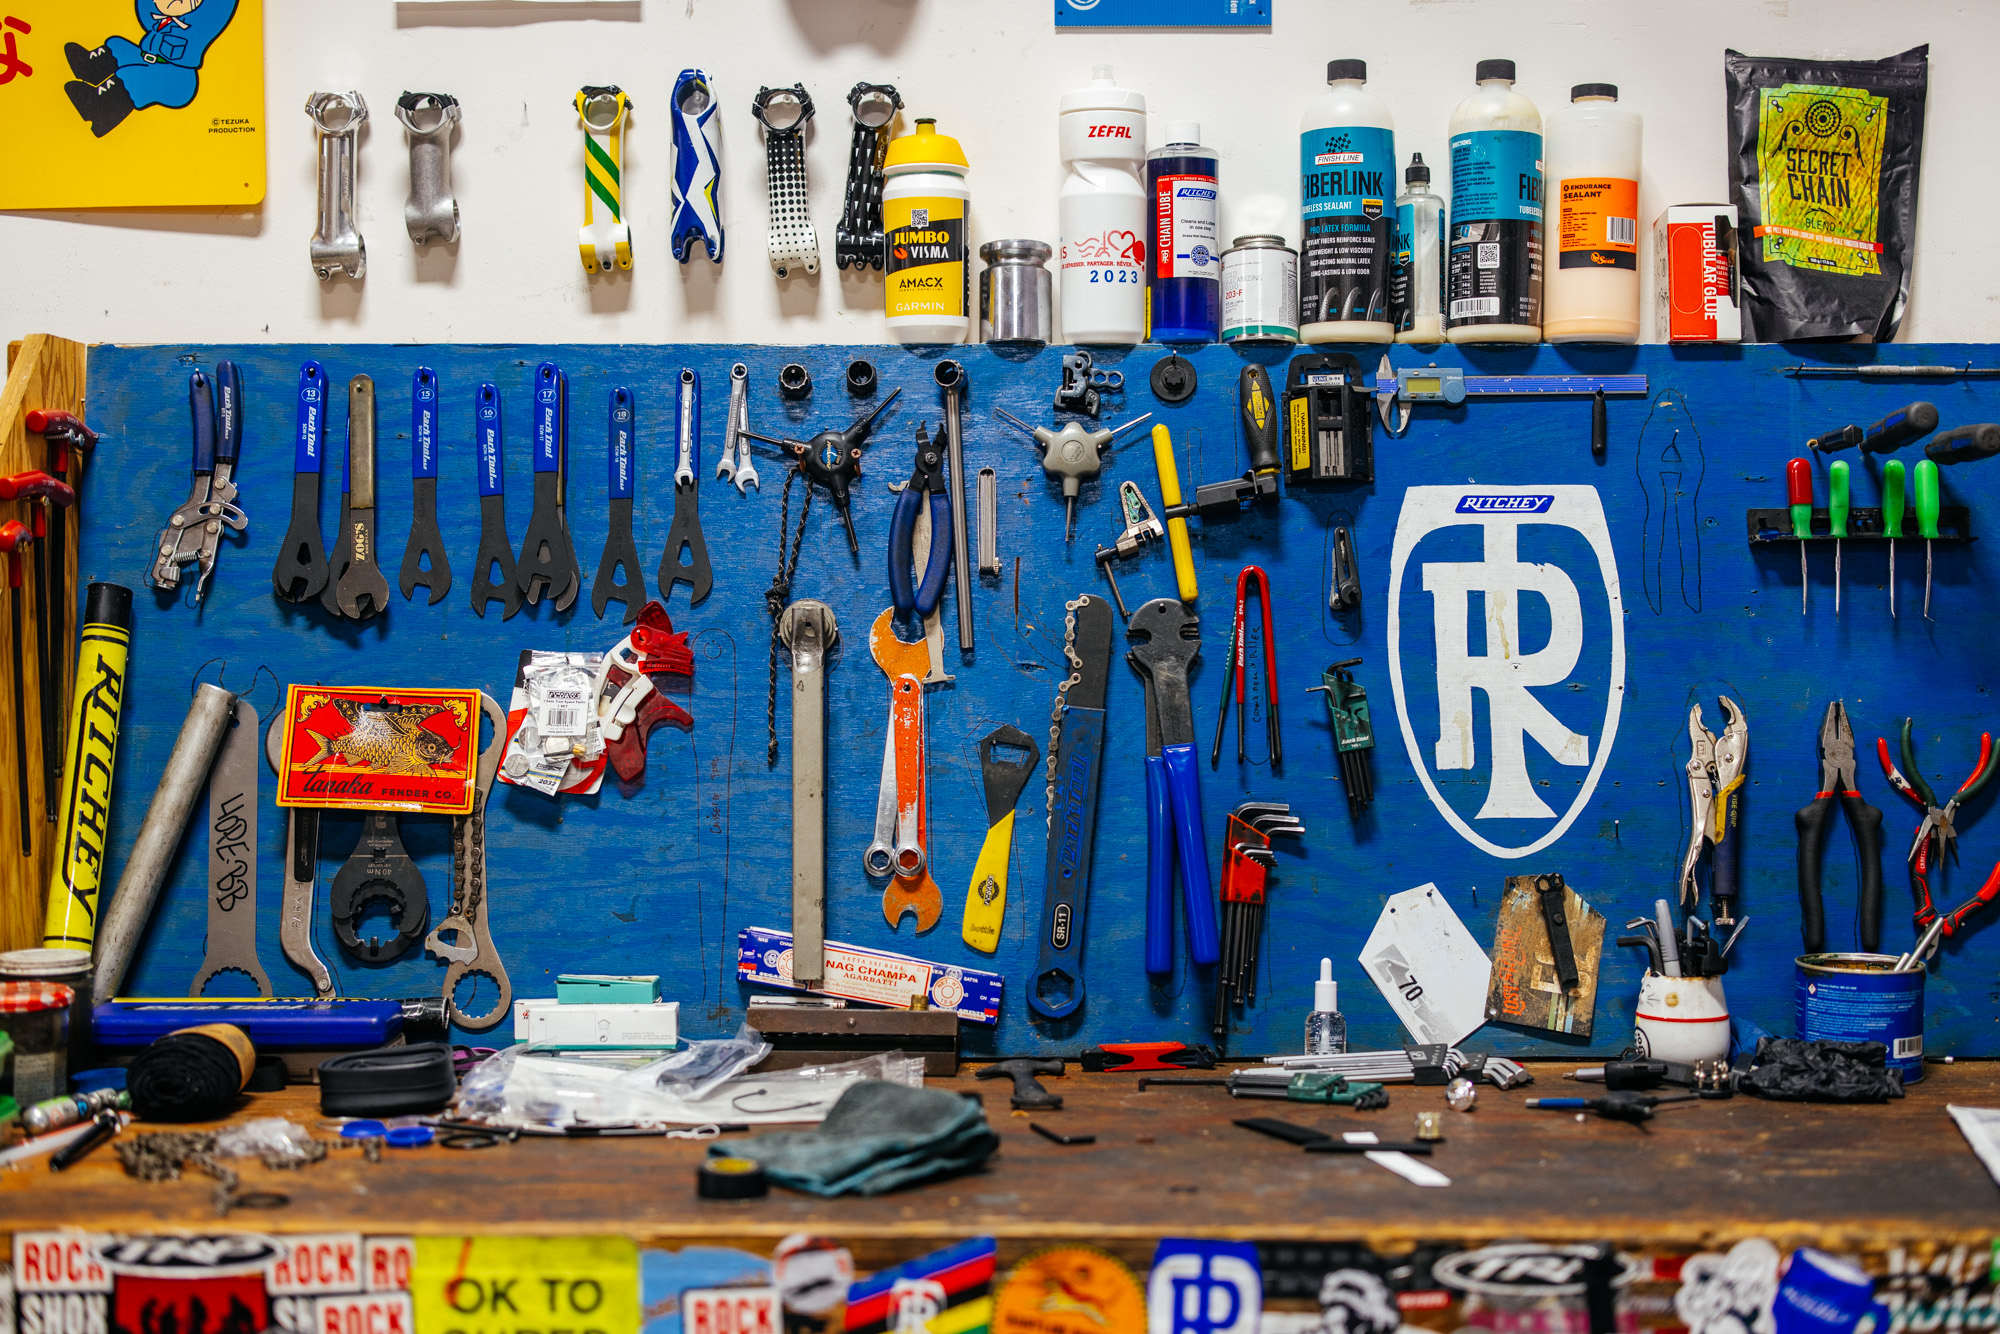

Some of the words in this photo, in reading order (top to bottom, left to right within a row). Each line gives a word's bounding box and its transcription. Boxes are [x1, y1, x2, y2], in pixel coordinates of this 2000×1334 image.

[1317, 155, 1340, 163] FINISH
[1786, 148, 1852, 178] SECRET
[1160, 190, 1171, 215] LUBE
[1180, 188, 1216, 199] RITCHEY
[1564, 191, 1602, 199] SEALANT
[1787, 173, 1851, 208] CHAIN
[1324, 201, 1352, 210] SEALANT
[1160, 218, 1171, 247] CHAIN
[1310, 226, 1320, 235] PRO
[1322, 224, 1339, 233] LATEX
[1341, 224, 1371, 232] FORMULA
[1805, 218, 1836, 232] BLEND
[893, 230, 950, 246] JUMBO
[910, 246, 949, 258] VISMA
[1702, 224, 1717, 283] TUBULAR
[899, 277, 943, 289] AMACX
[1090, 270, 1138, 283] 2023
[1226, 289, 1242, 299] 203-F
[1704, 287, 1717, 320] GLUE
[896, 302, 944, 312] GARMIN
[308, 406, 317, 432] Park
[423, 410, 431, 435] Park
[545, 407, 553, 434] Park
[307, 433, 316, 457] Tool
[423, 436, 431, 460] Tool
[487, 428, 495, 454] Park
[545, 434, 553, 459] Tool
[619, 430, 627, 455] Park
[488, 454, 497, 478] Tool
[1462, 497, 1548, 511] RITCHEY
[355, 523, 365, 560] ZOG'S
[62, 653, 122, 927] RITCHEY
[382, 788, 429, 798] FENDER
[435, 790, 455, 799] CO.
[538, 778, 557, 787] 2032
[1056, 912, 1067, 941] SR-11
[826, 960, 854, 972] NAG
[858, 966, 917, 983] CHAMPA
[843, 972, 897, 987] AGARBATTI
[1399, 975, 1423, 1002] 70
[1502, 983, 1526, 1016] LOST
[373, 1246, 411, 1288] RO
[452, 1277, 520, 1315] OK
[541, 1278, 604, 1315] TO
[695, 1299, 773, 1334] ROCK
